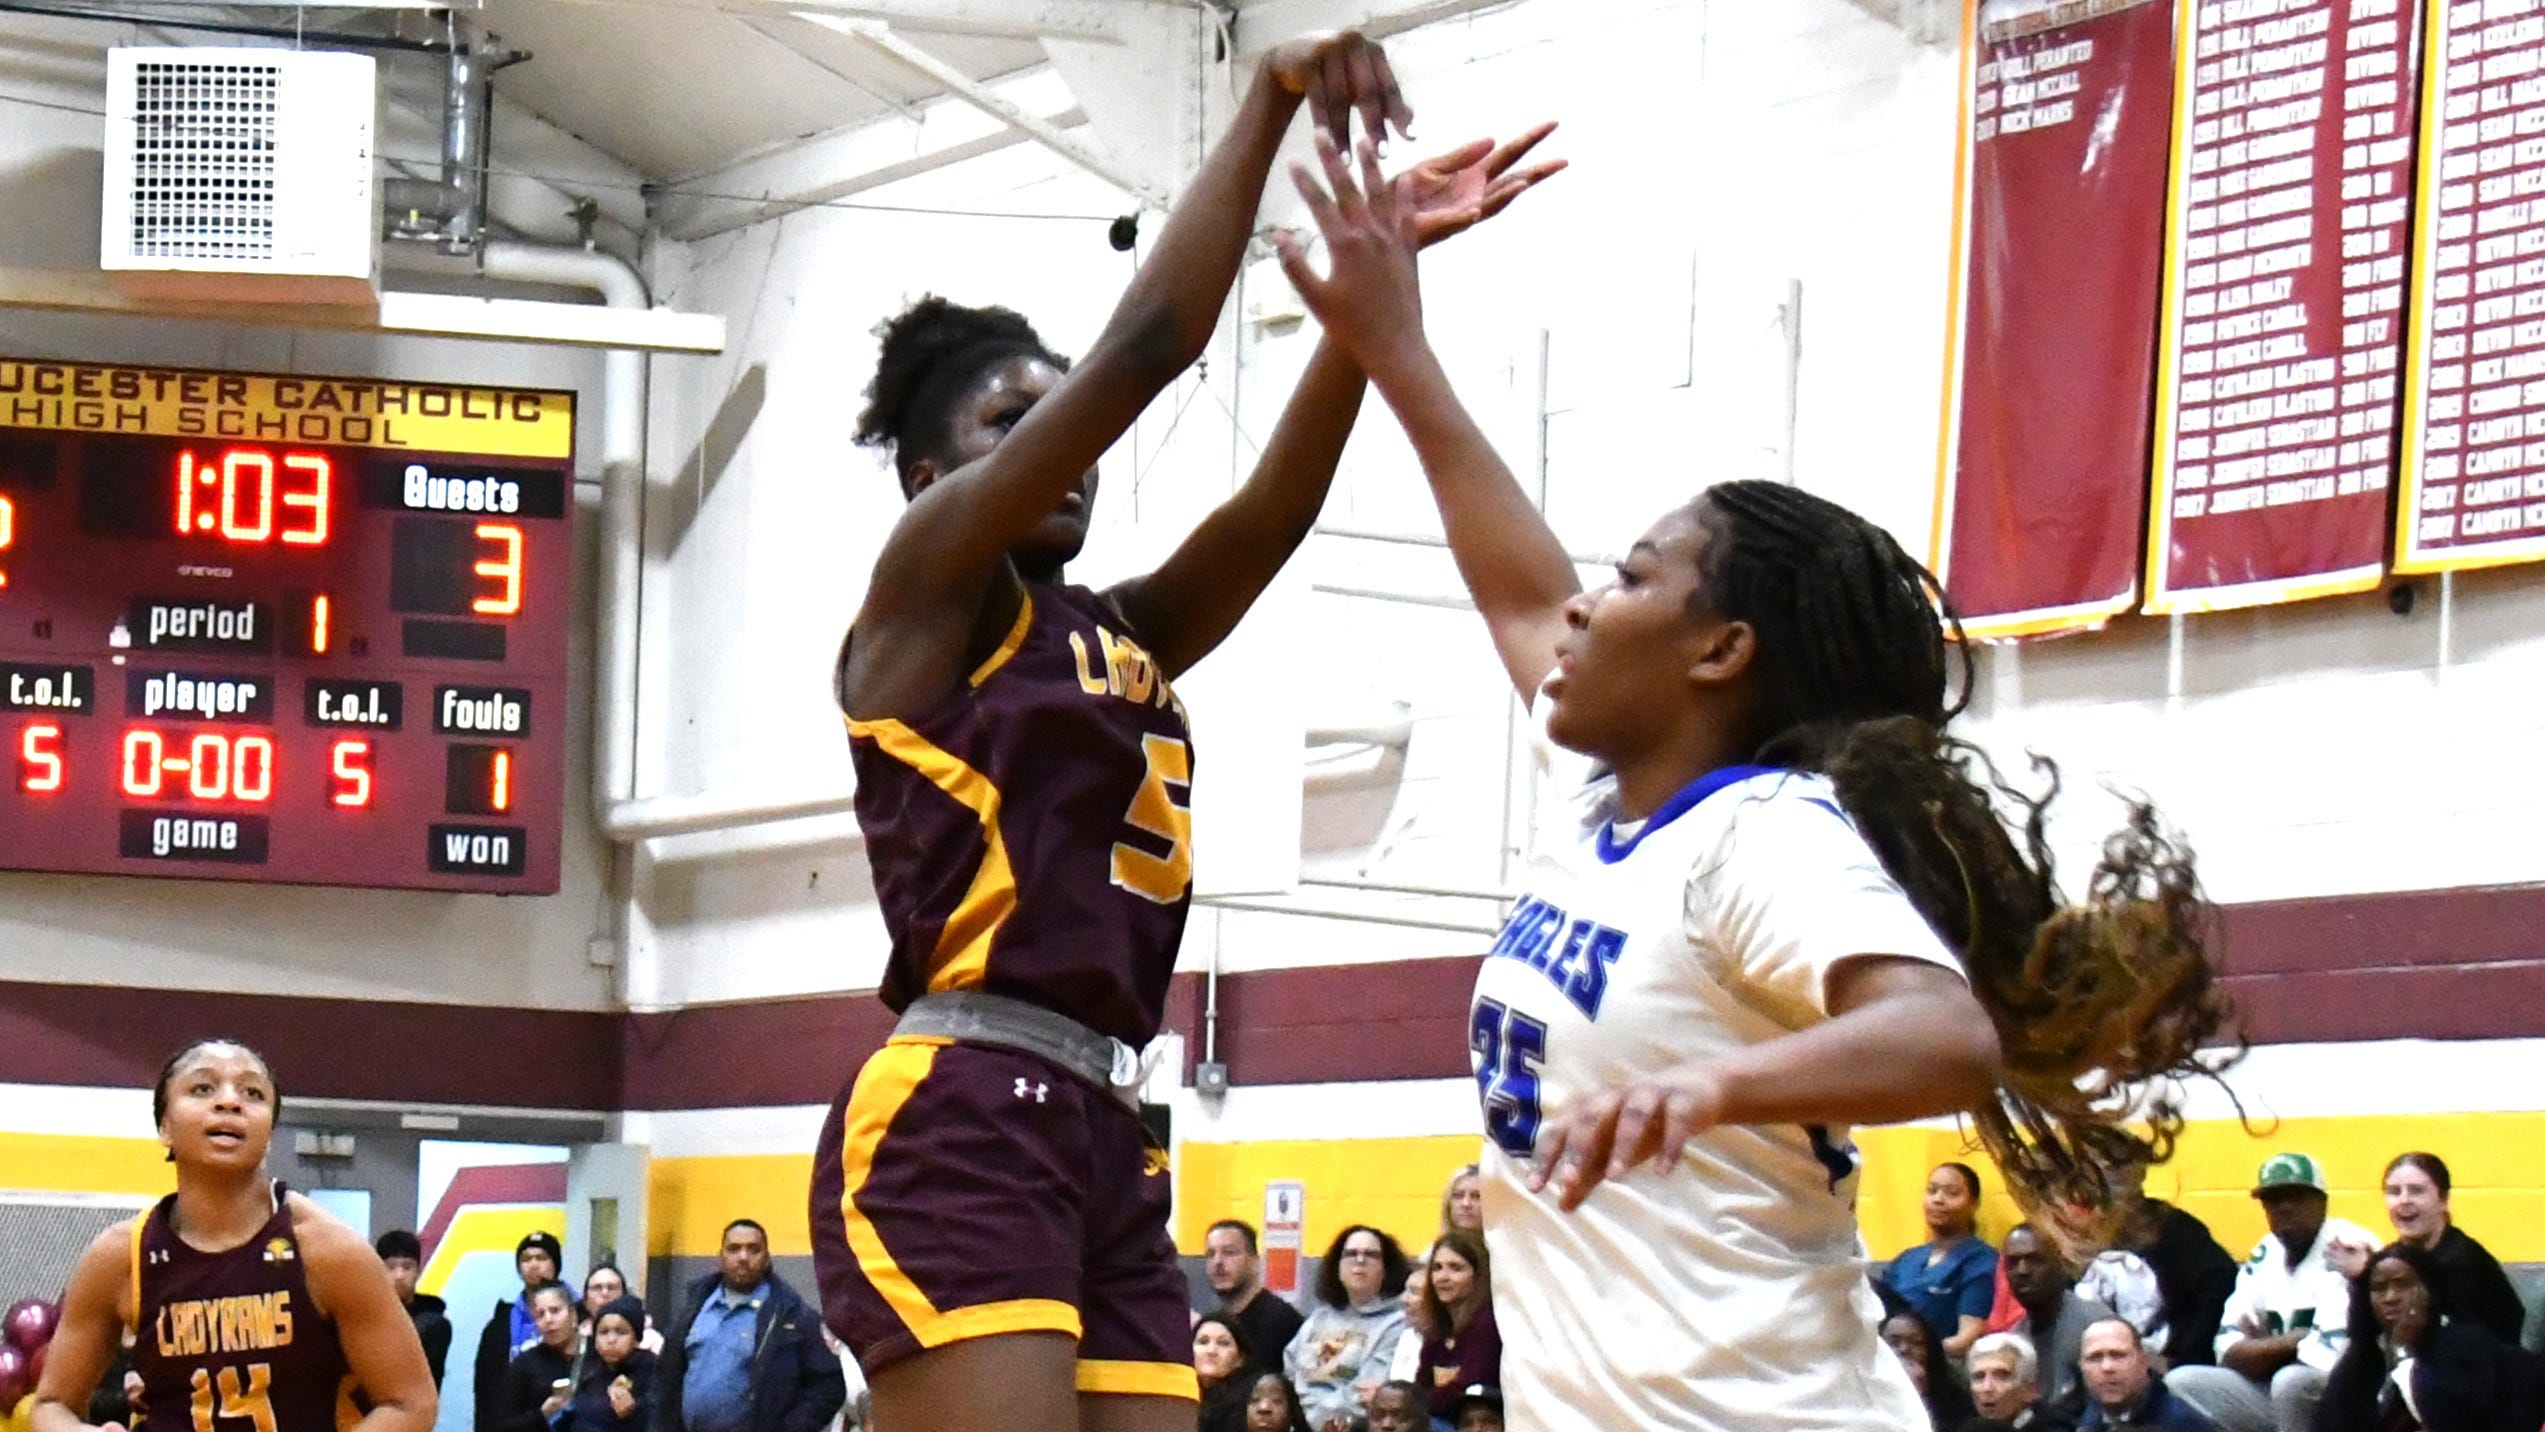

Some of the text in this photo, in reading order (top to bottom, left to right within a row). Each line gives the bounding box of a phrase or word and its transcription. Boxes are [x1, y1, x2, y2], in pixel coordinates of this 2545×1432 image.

[11, 397, 408, 445] HIGH SCHOOL
[273, 379, 542, 423] CATHOLIC
[176, 452, 331, 545] 1:03
[403, 464, 519, 512] Guests
[473, 524, 523, 615] 3
[149, 602, 255, 644] period
[313, 595, 328, 654] 1
[10, 671, 83, 708] t.o.l.
[144, 671, 257, 719] player
[317, 688, 389, 724] t.o.l.
[442, 690, 521, 733] fouls
[22, 725, 62, 792] 5
[122, 730, 272, 802] 0-00
[332, 741, 372, 807] 5
[493, 752, 509, 811] 1
[153, 816, 238, 855] game
[1109, 731, 1193, 905] 5
[446, 834, 510, 866] won
[190, 1362, 278, 1432] 14
